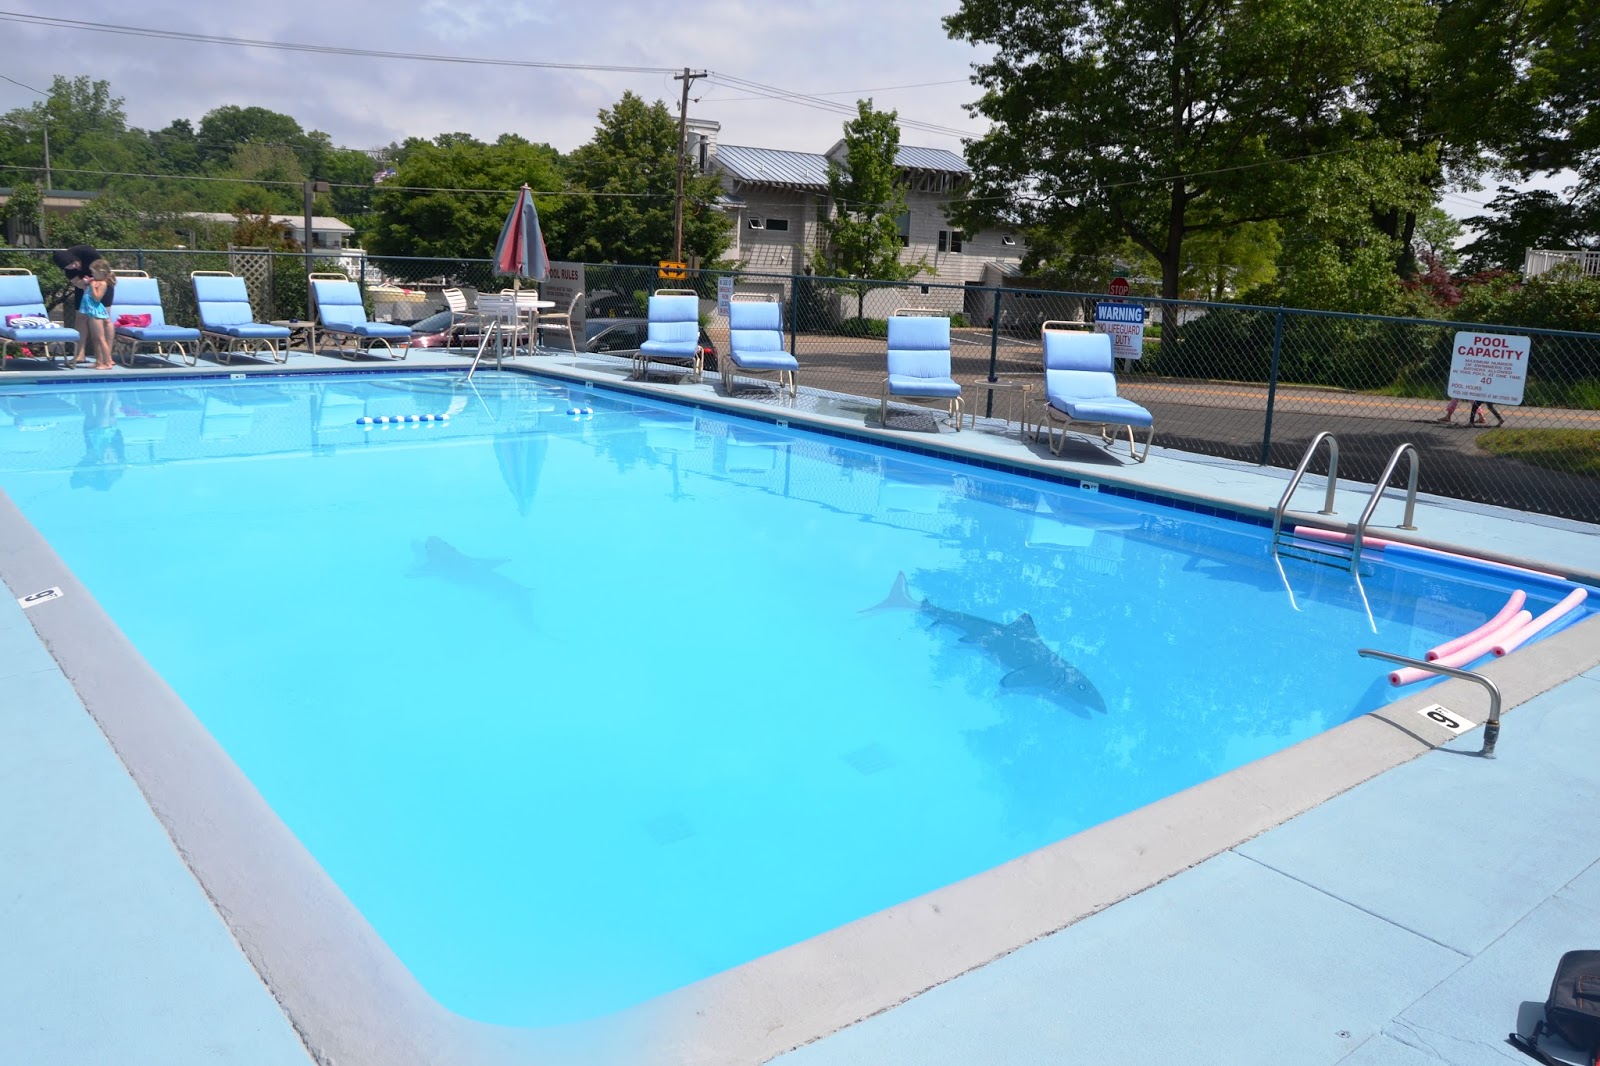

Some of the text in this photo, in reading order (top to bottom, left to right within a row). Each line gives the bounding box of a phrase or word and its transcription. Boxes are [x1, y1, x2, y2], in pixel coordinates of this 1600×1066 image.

[548, 268, 578, 280] OOL RULES
[1110, 285, 1128, 296] STOP
[1098, 306, 1142, 322] WARNING
[1108, 324, 1140, 335] LIFEGUARD
[1116, 334, 1132, 345] DUTY
[1474, 336, 1509, 348] POOL
[1458, 346, 1524, 360] CAPACITY
[25, 590, 54, 602] 9
[1427, 711, 1460, 728] 9
